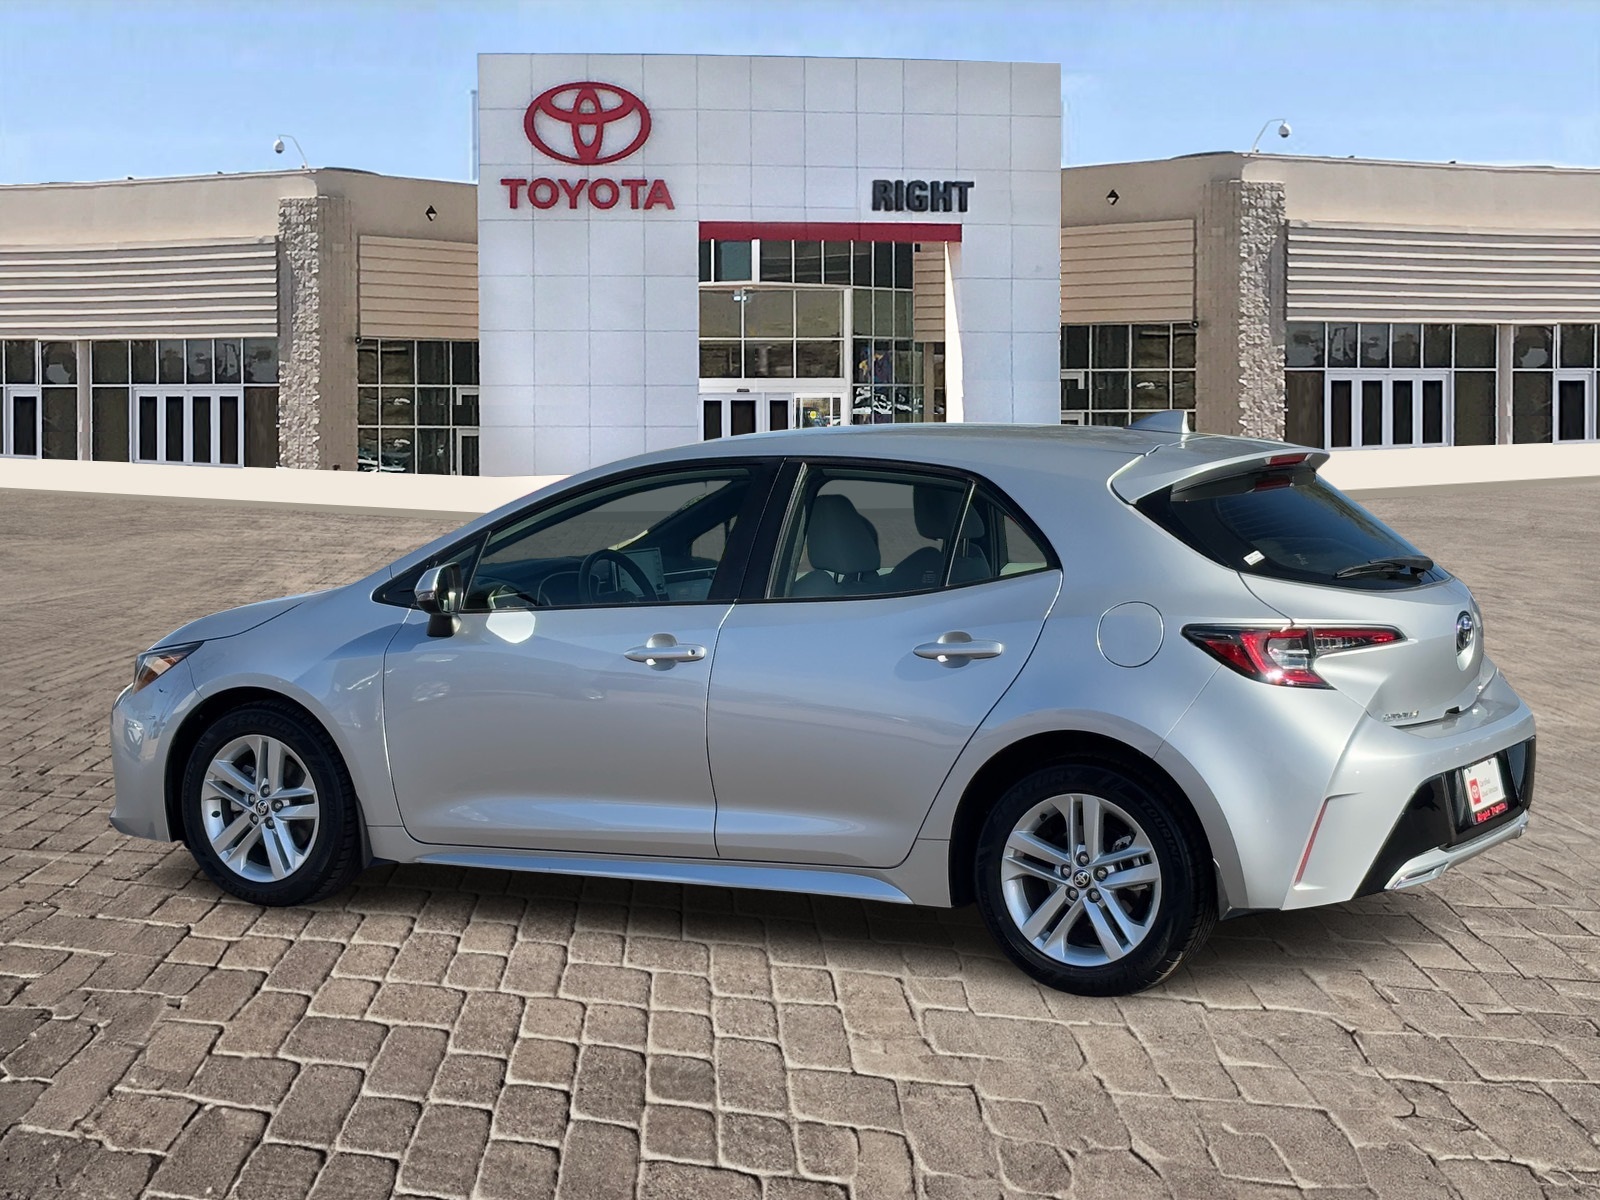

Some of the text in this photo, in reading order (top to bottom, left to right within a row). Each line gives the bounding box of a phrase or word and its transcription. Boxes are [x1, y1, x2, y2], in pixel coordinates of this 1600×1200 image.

[500, 178, 674, 210] TOYOTA
[872, 179, 975, 213] RIGHT
[1140, 799, 1183, 867] TOURING
